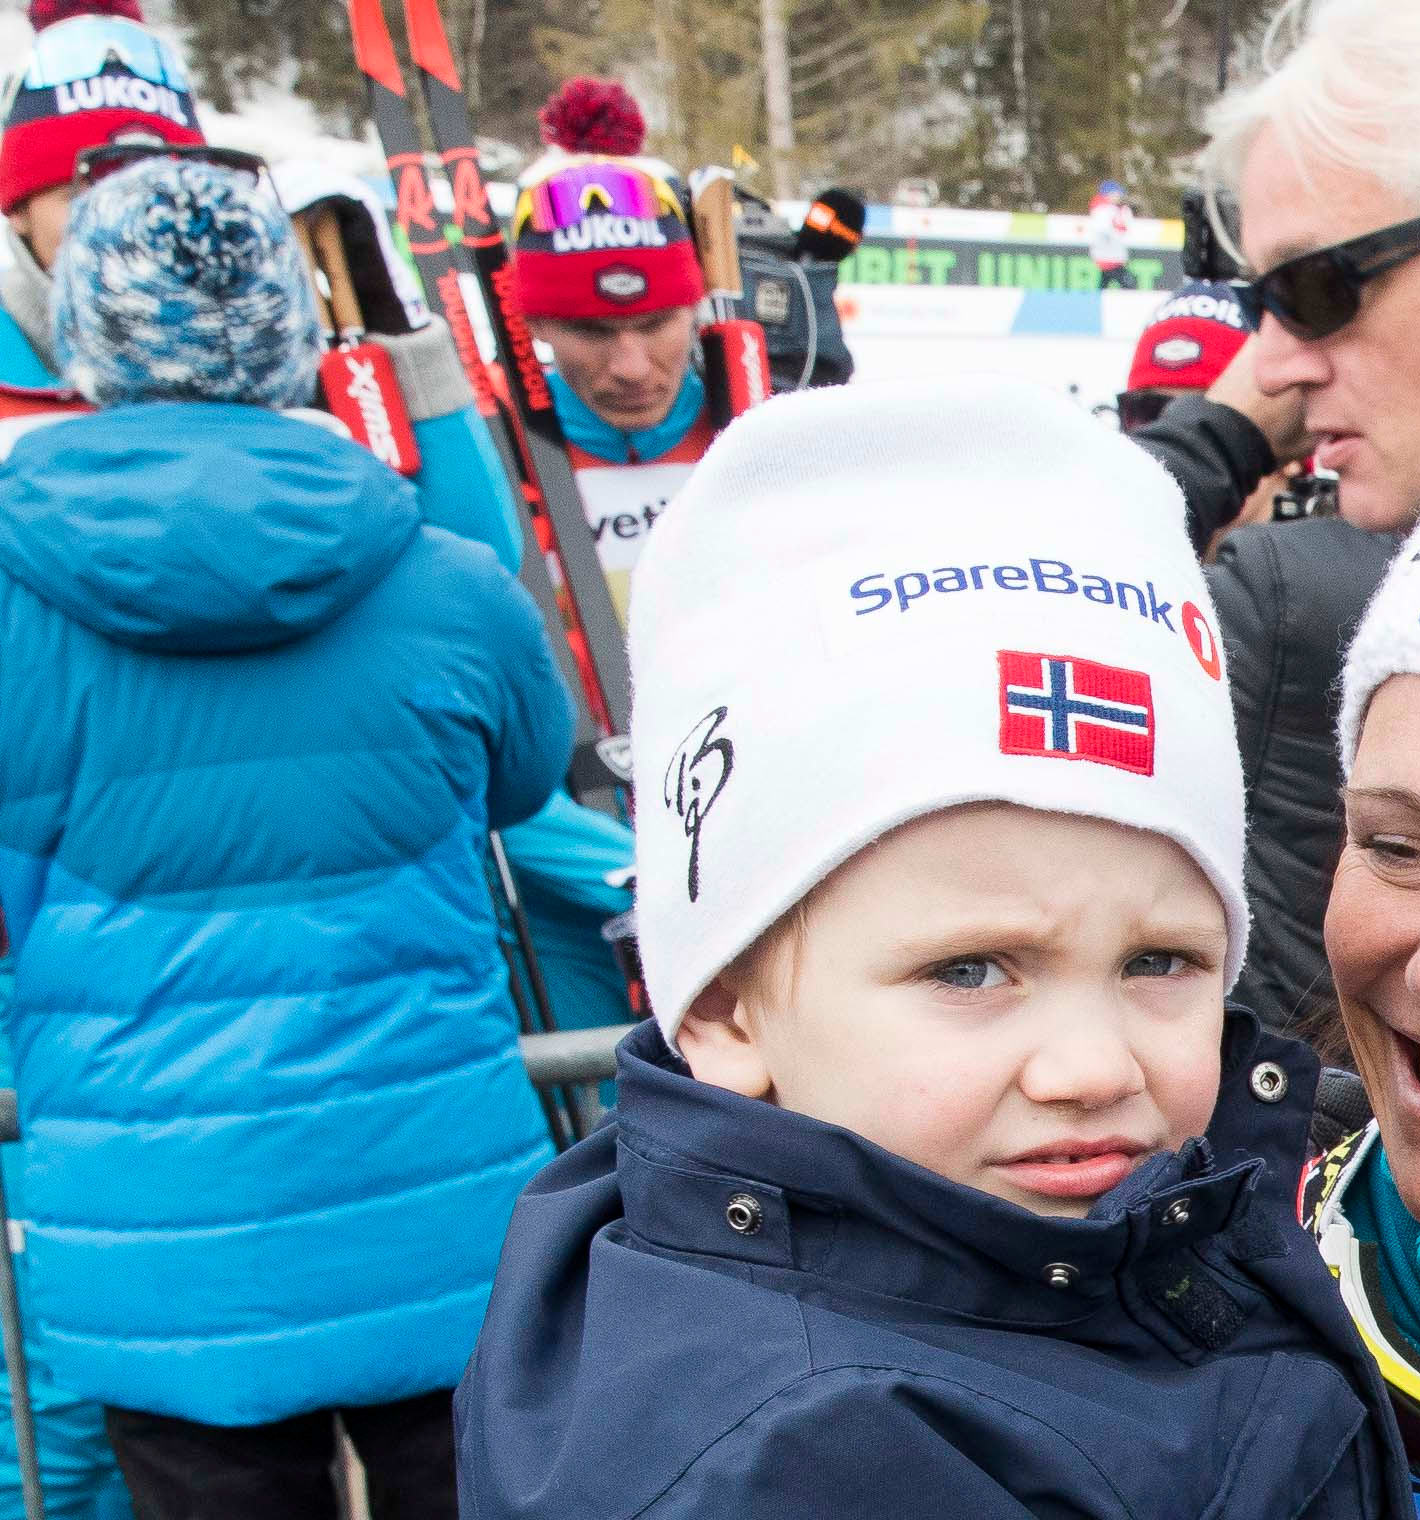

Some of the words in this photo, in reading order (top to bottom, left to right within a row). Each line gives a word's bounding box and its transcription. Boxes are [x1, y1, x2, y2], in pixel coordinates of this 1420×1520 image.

[55, 75, 188, 127] LUKOIL
[553, 214, 668, 252] LUKOIL
[977, 252, 1164, 291] UNIBT
[849, 557, 1177, 633] SpareBank
